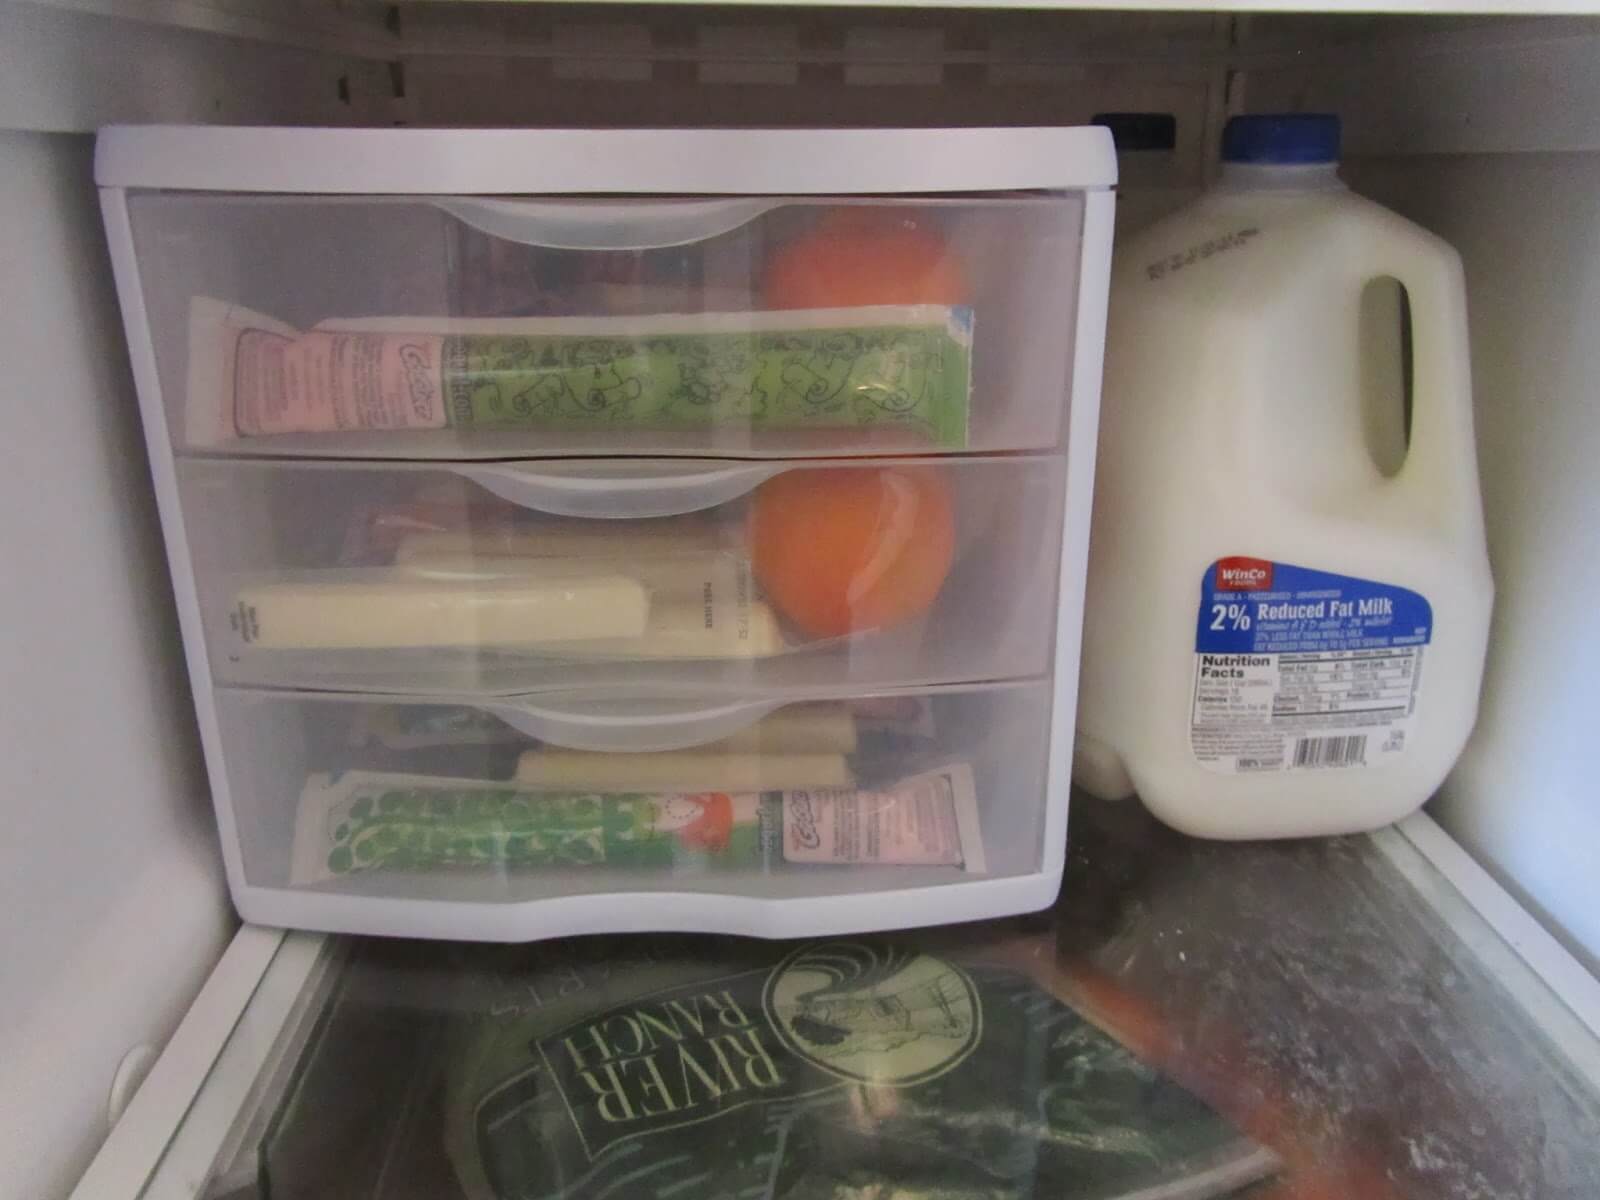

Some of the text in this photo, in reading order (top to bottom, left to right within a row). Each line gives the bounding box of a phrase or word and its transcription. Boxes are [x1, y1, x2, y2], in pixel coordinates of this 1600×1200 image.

[1222, 568, 1266, 580] WinCo
[1210, 604, 1251, 631] 2%
[1258, 598, 1393, 620] Reduced Fat Milk
[1202, 655, 1271, 666] Nutrition
[1201, 667, 1244, 678] Facts
[564, 991, 750, 1073] RANCH
[579, 1028, 782, 1122] RIVER
